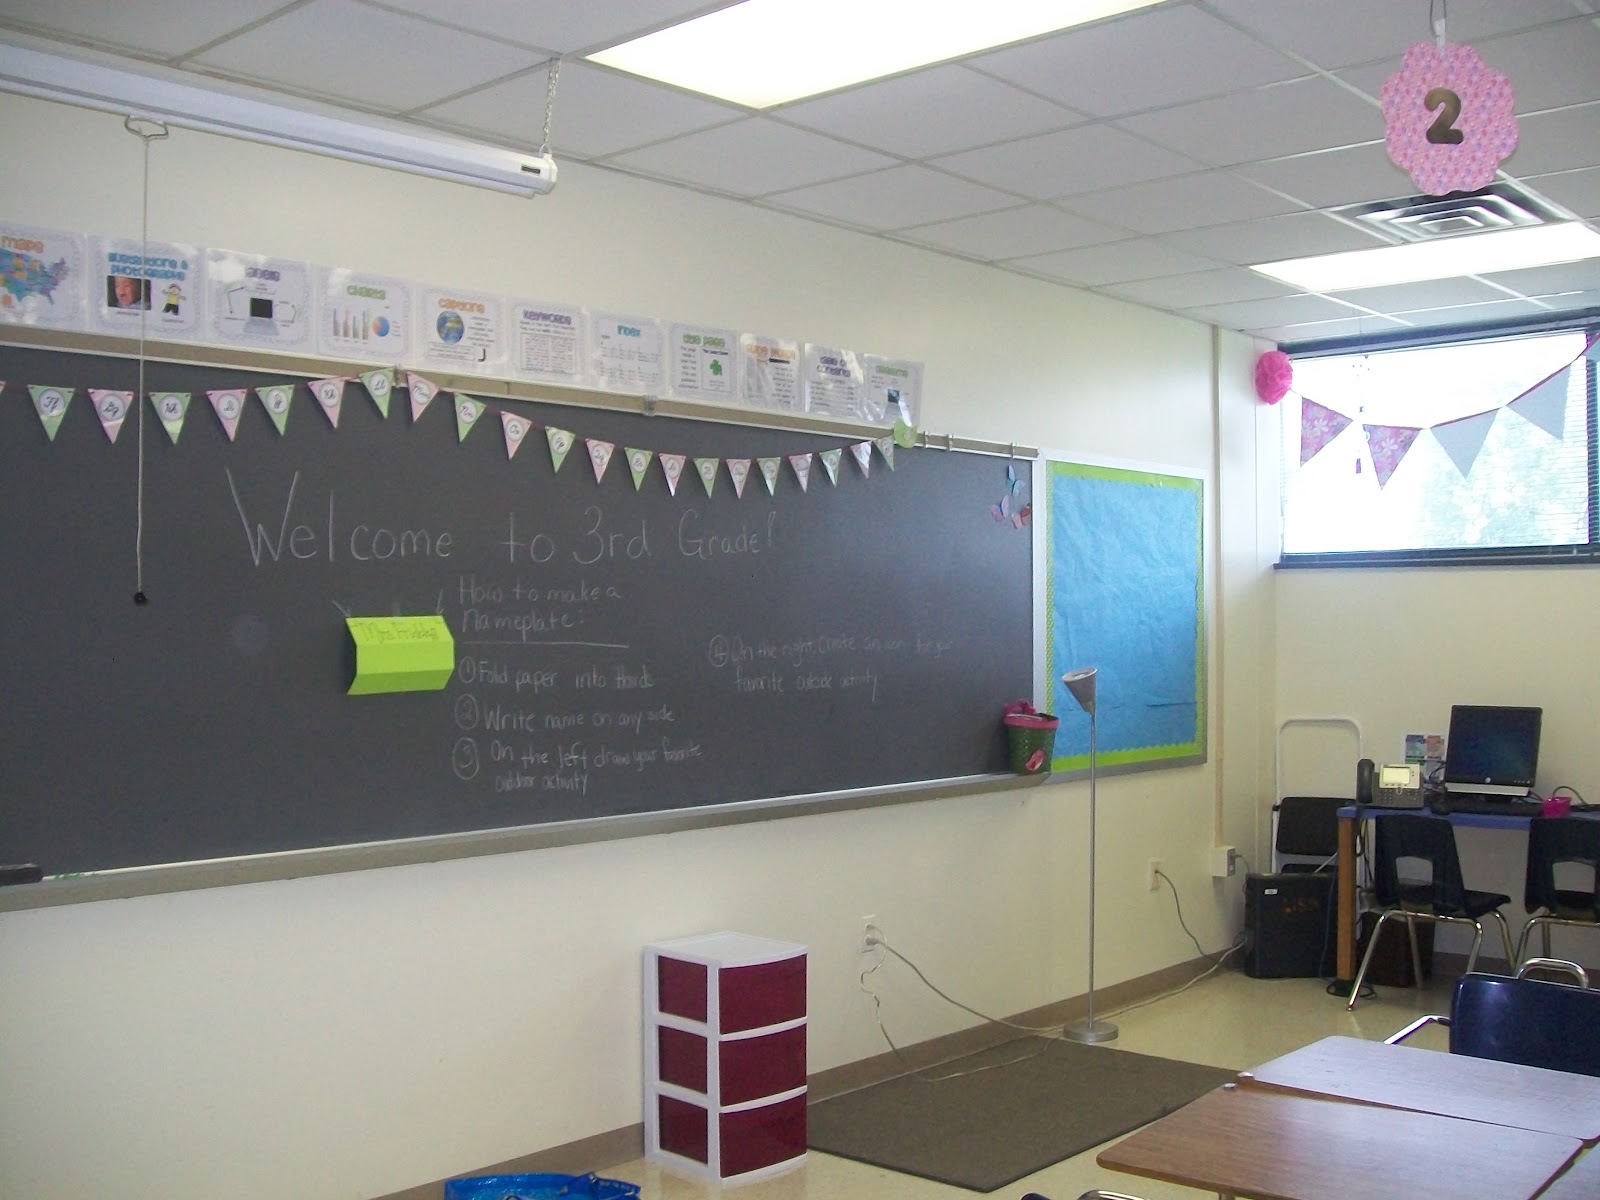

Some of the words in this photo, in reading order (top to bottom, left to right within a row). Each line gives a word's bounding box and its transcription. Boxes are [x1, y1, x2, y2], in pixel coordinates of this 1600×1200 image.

[1424, 87, 1464, 145] 2
[224, 466, 452, 566] Welcome
[500, 511, 555, 563] to
[572, 505, 651, 564] 3rd
[678, 508, 776, 559] Grade!
[458, 573, 503, 605] How
[511, 575, 539, 602] to
[546, 575, 600, 602] make
[605, 585, 622, 599] a
[731, 635, 754, 662] On
[757, 639, 777, 659] the
[479, 660, 508, 684] Fold
[515, 671, 559, 694] paper
[575, 664, 607, 688] into
[485, 704, 535, 732] Write
[544, 713, 584, 730] name
[593, 712, 612, 727] on
[618, 711, 642, 734] any
[490, 739, 513, 761] On
[521, 743, 549, 769] the
[559, 740, 587, 769] left
[594, 743, 631, 768] draw
